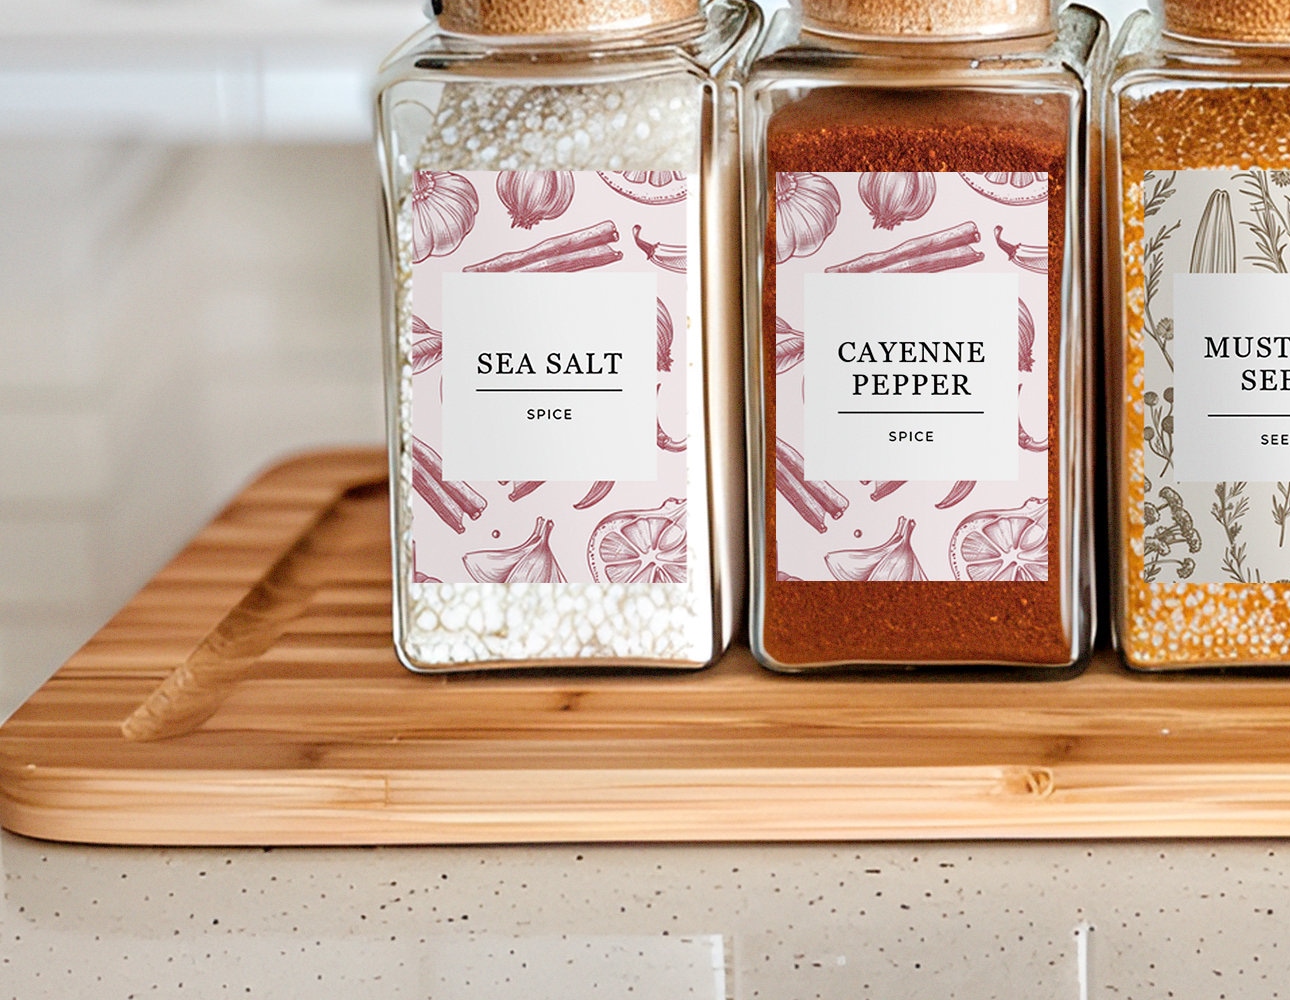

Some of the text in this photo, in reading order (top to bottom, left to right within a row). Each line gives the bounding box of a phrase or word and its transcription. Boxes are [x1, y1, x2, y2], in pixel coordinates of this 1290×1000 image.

[837, 341, 986, 363] CAYENNE
[477, 352, 623, 375] SEA SALT
[852, 373, 972, 396] PEPPER
[526, 408, 572, 420] SPICE
[888, 430, 934, 442] SPICE
